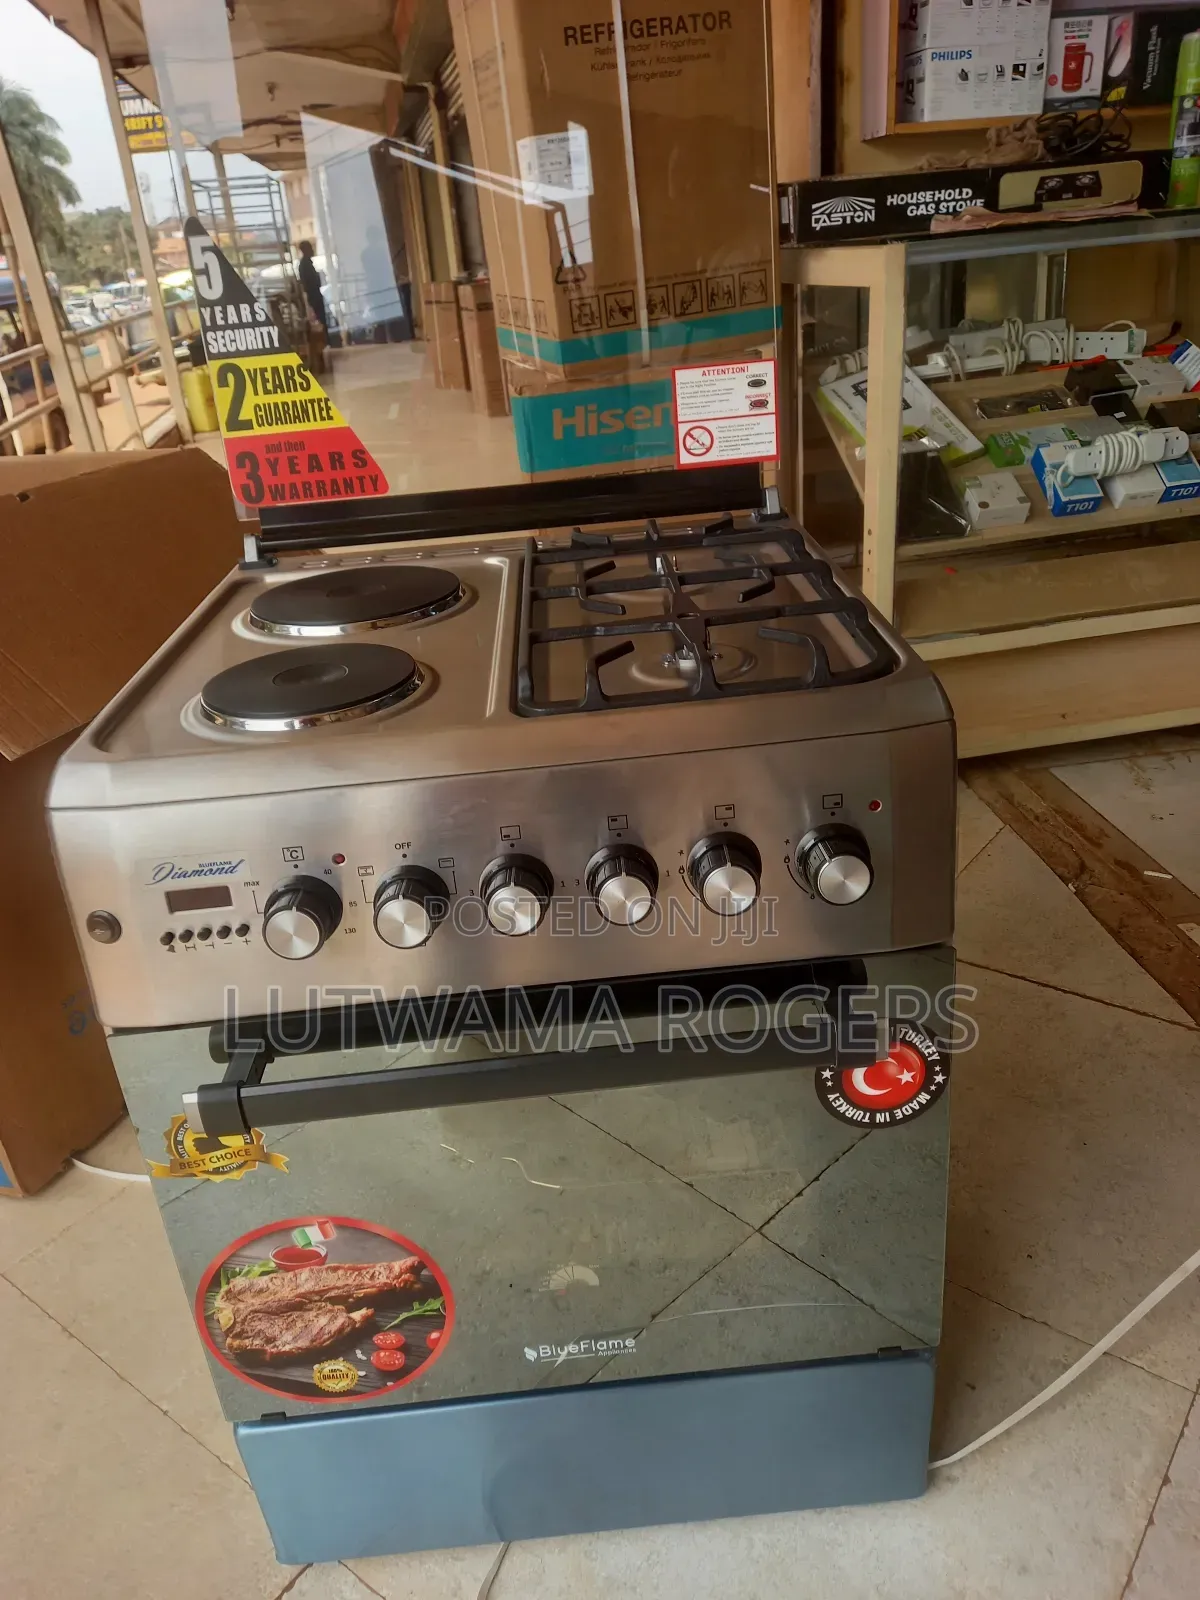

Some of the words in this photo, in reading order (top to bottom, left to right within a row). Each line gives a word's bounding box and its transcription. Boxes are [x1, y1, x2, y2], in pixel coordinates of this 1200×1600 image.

[931, 49, 973, 61] PHILIPS
[886, 187, 973, 206] HOUSEHOLD
[906, 203, 936, 217] GAS
[188, 234, 224, 301] 5
[200, 301, 267, 327] YEARS
[205, 325, 280, 354] SECURITY
[245, 362, 311, 397] YEARS
[702, 366, 749, 377] ATTENTION!
[745, 372, 768, 380] CORRECT
[216, 362, 254, 433] 2
[253, 397, 334, 428] GUARANTEE
[264, 441, 282, 454] and
[283, 439, 306, 452] then
[266, 448, 369, 477] YEARS
[235, 450, 265, 505] 3
[266, 473, 380, 503] WARRANTY
[1171, 485, 1199, 498] T101
[1066, 500, 1095, 513] T101
[394, 841, 412, 850] OFF
[144, 859, 245, 886] Diamond
[198, 859, 232, 869] BLUEFLAME
[323, 868, 332, 876] 40
[560, 880, 565, 888] 1
[574, 879, 580, 887] 3
[469, 889, 475, 897] 3
[344, 927, 356, 935] 130
[899, 1027, 941, 1062] TURKEY
[827, 1092, 871, 1123] TURKEY
[895, 1091, 931, 1120] MADE
[875, 1112, 890, 1124] IN
[179, 1159, 207, 1170] BEST
[208, 1148, 252, 1165] CHOICE
[539, 1337, 636, 1357] BlueFlame
[322, 1372, 349, 1381] QUALITY
